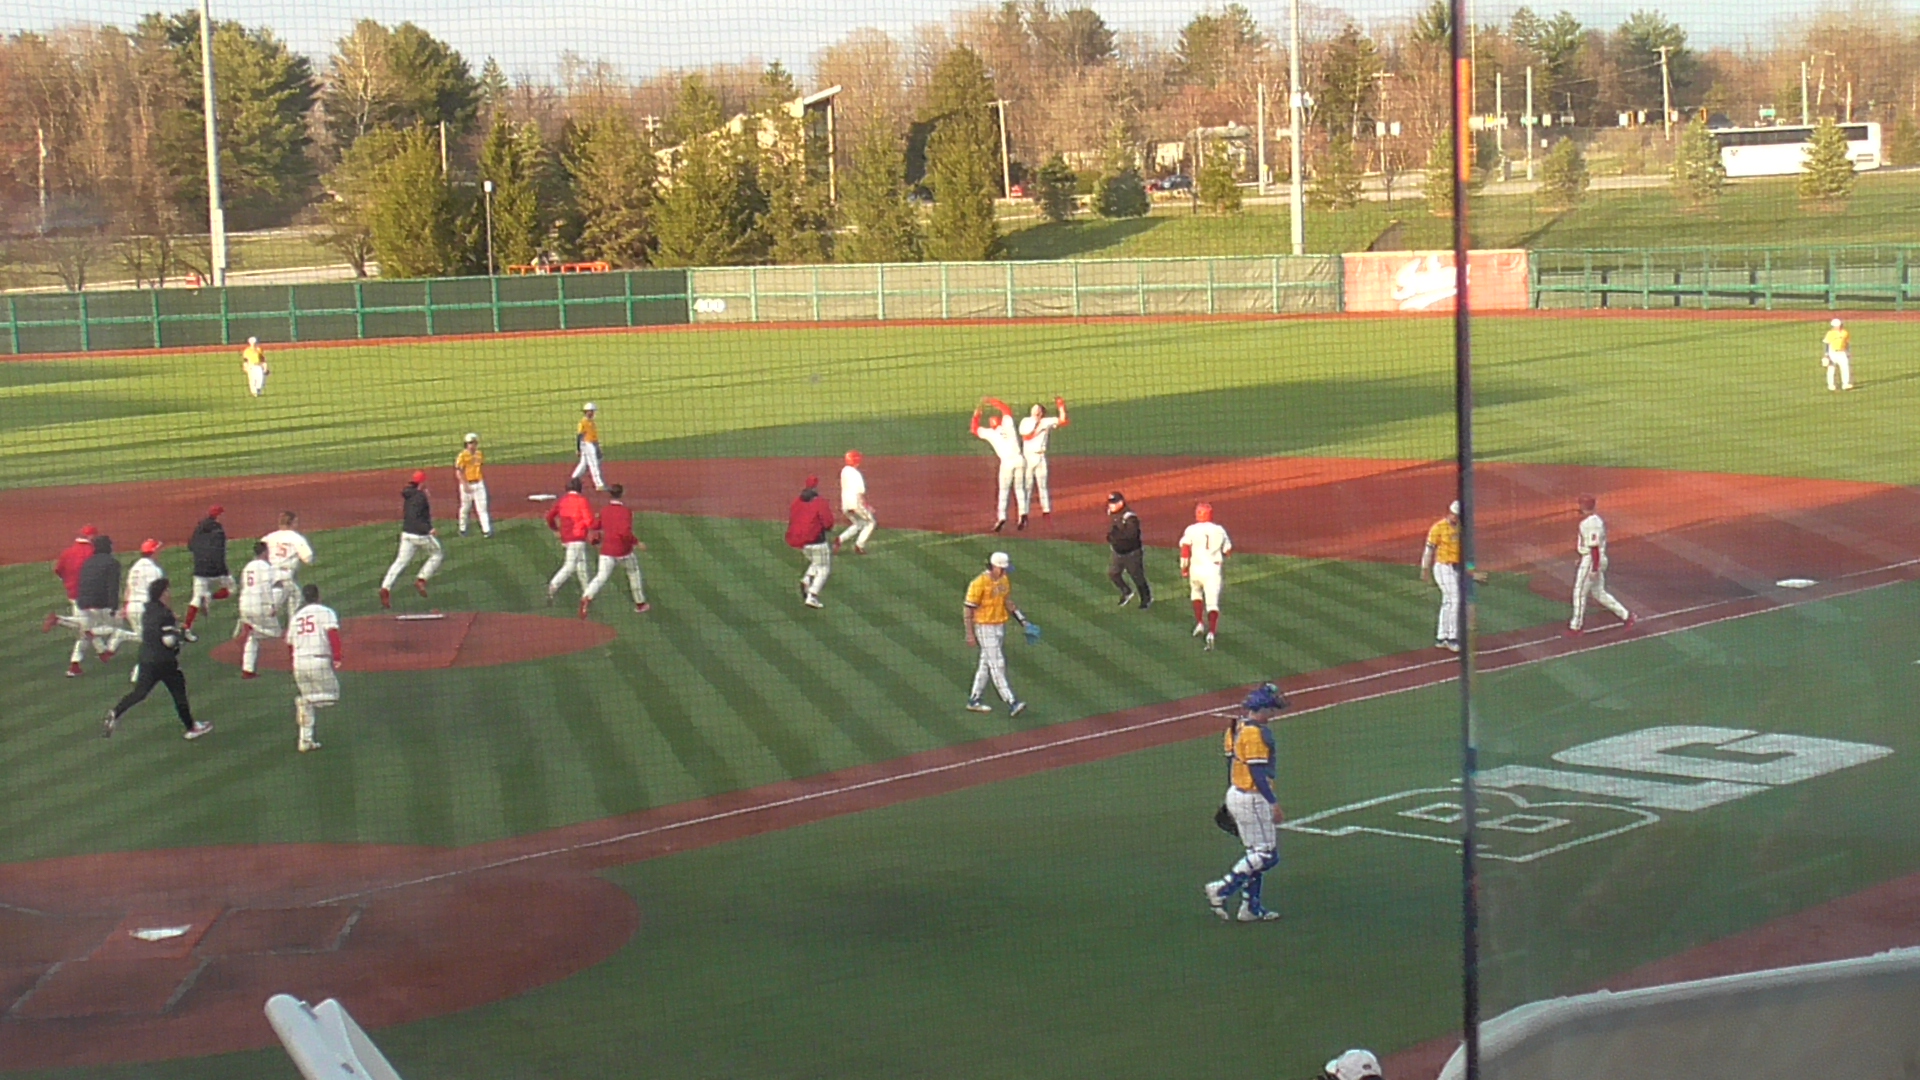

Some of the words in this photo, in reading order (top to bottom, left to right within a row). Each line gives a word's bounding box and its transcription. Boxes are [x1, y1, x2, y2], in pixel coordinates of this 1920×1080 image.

[693, 298, 726, 313] 400
[1204, 533, 1210, 551] 1
[246, 569, 255, 587] 6
[296, 614, 315, 636] 35
